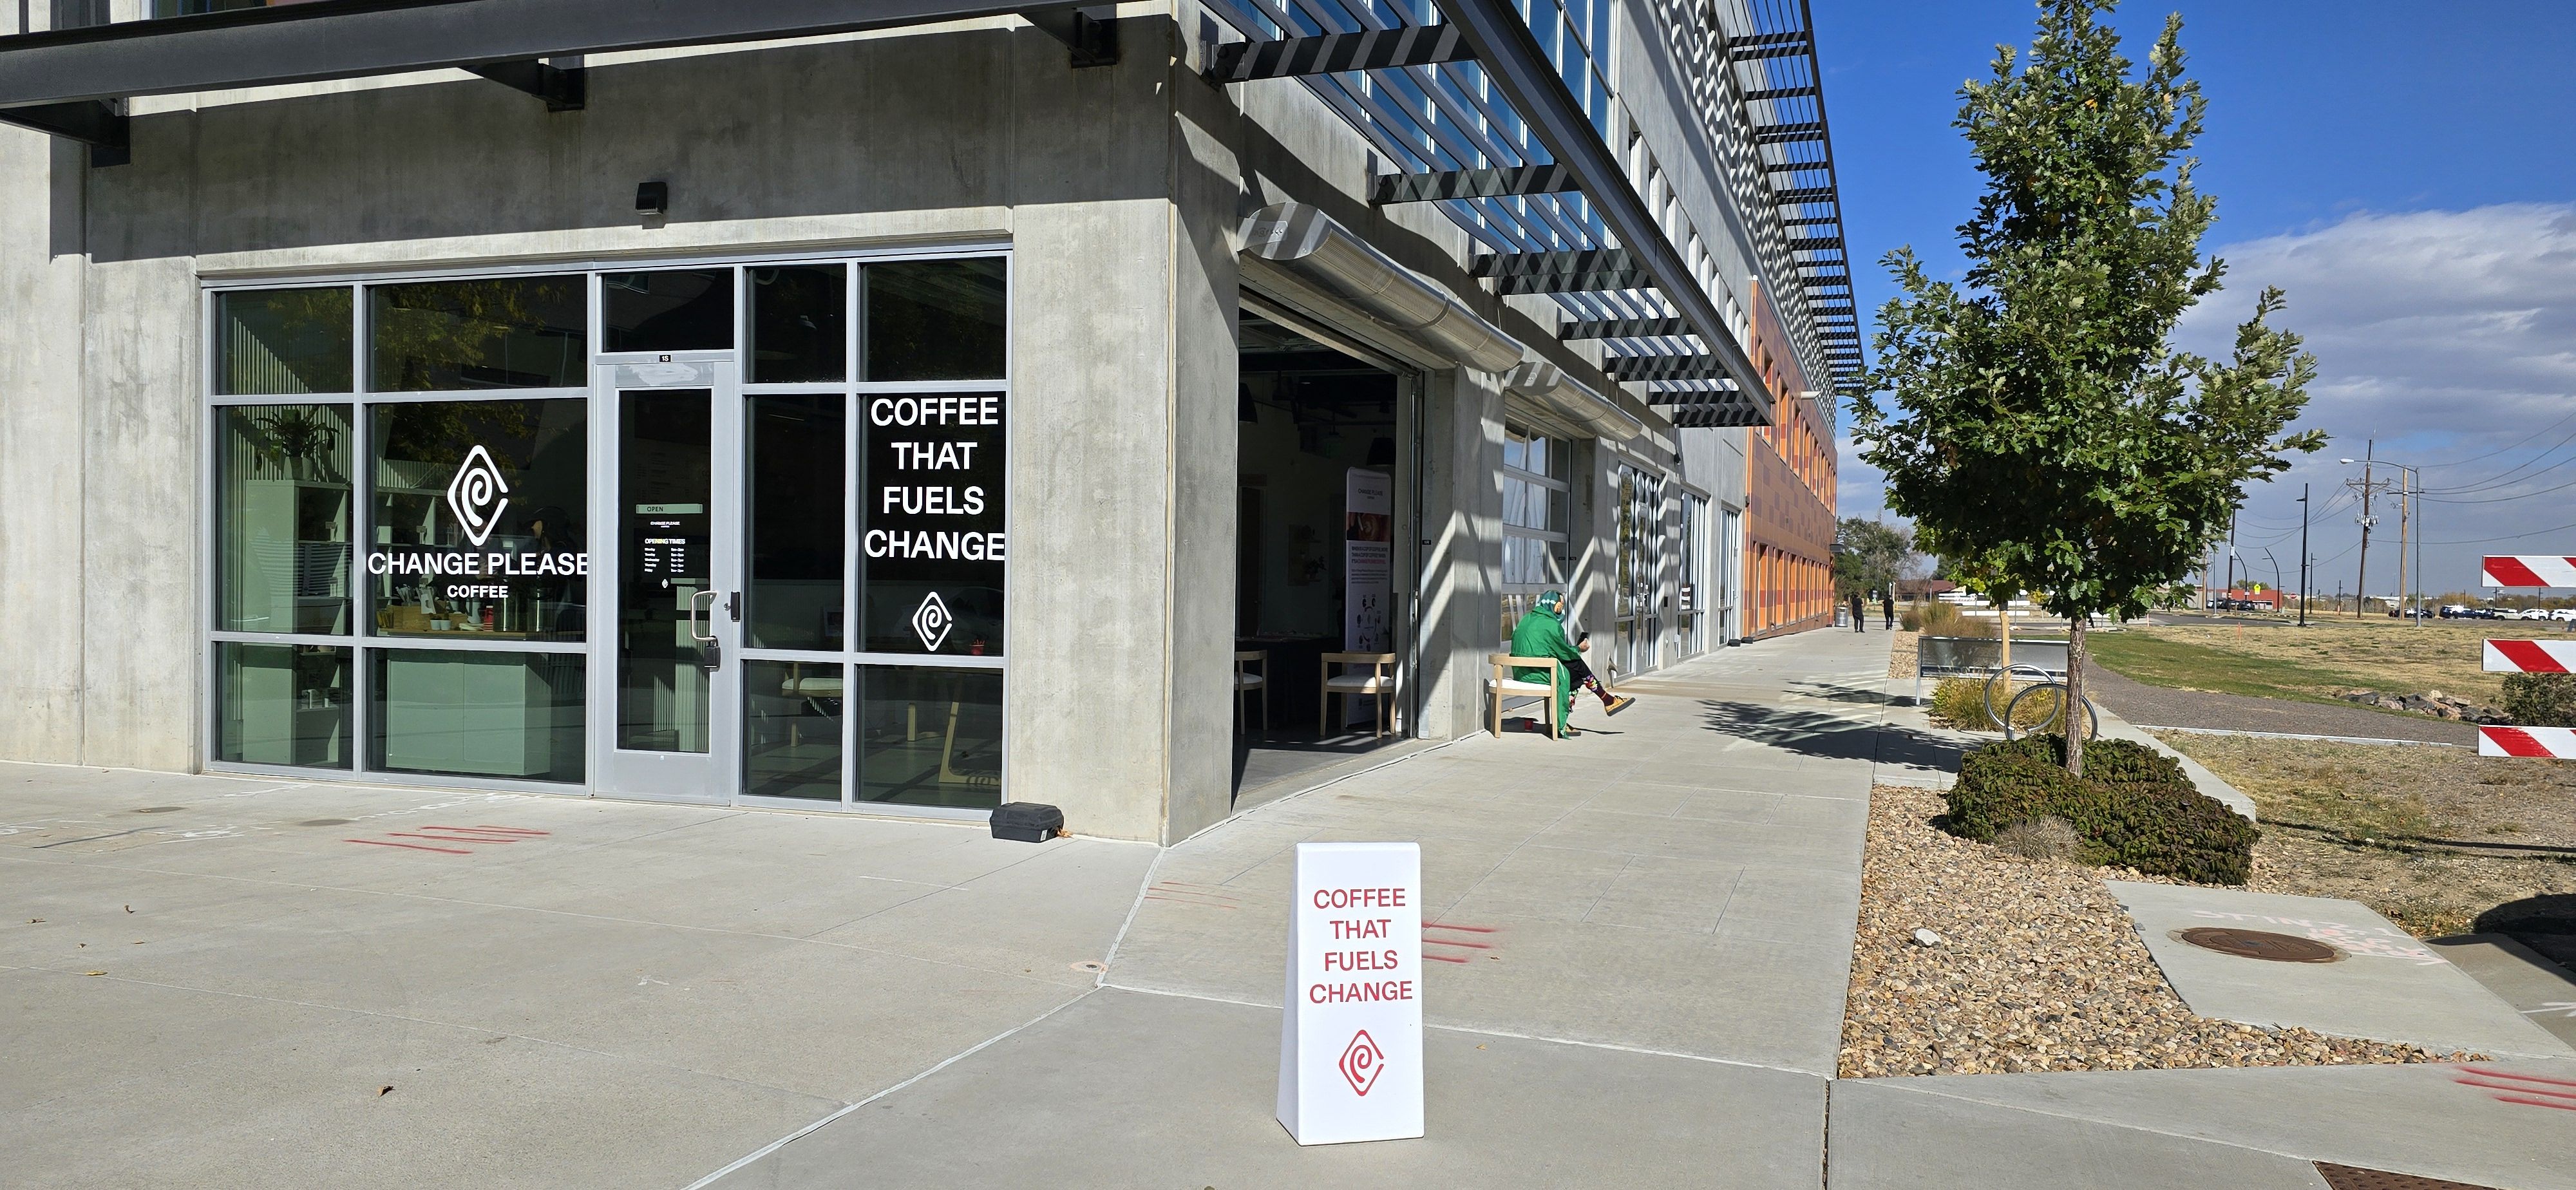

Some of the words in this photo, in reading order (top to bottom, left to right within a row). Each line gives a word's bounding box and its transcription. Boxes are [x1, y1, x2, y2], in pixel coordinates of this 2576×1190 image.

[871, 397, 998, 426] COFFEE
[891, 442, 978, 470] THAT
[884, 486, 984, 515] FUELS
[864, 529, 1005, 561] CHANGE
[368, 552, 480, 575] CHANGE
[488, 552, 588, 576] PLEASE
[447, 585, 509, 598] COFFEE
[1314, 888, 1406, 909] COFFEE
[1330, 919, 1392, 939] THAT
[1325, 950, 1398, 971] FUELS
[1309, 981, 1413, 1004] CHANGE
